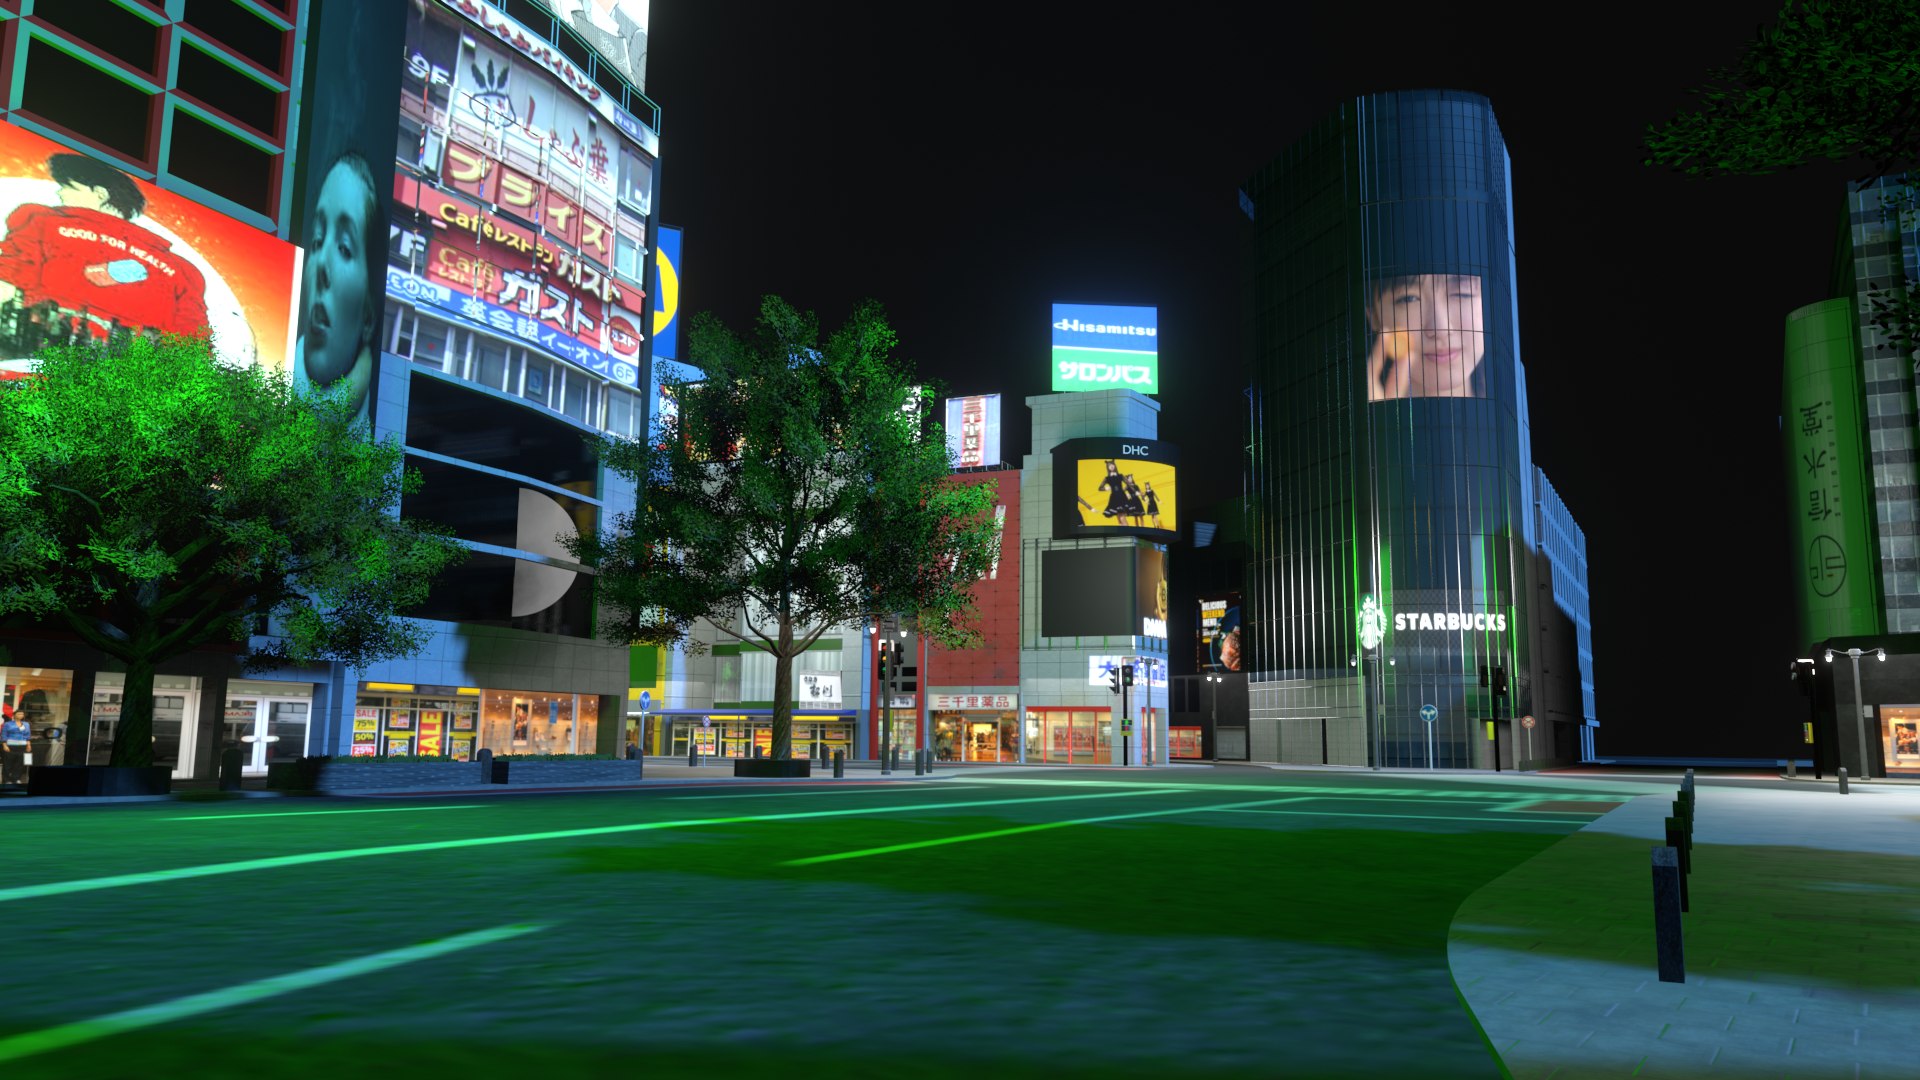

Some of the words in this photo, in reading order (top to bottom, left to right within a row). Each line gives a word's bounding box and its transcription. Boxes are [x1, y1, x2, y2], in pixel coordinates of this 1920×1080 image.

[408, 53, 449, 84] 9F
[100, 234, 127, 251] FOR
[129, 245, 176, 277] HEALTH
[499, 269, 594, 335] ガスト
[1053, 319, 1157, 337] Hisamitsu
[616, 365, 633, 380] 6F
[1058, 360, 1153, 385] サロンパス
[1122, 444, 1149, 456] DHC
[1395, 612, 1506, 632] STARBUCKS
[937, 695, 1010, 708] 三千里薬品
[355, 708, 377, 718] SALE
[356, 719, 375, 728] 75%
